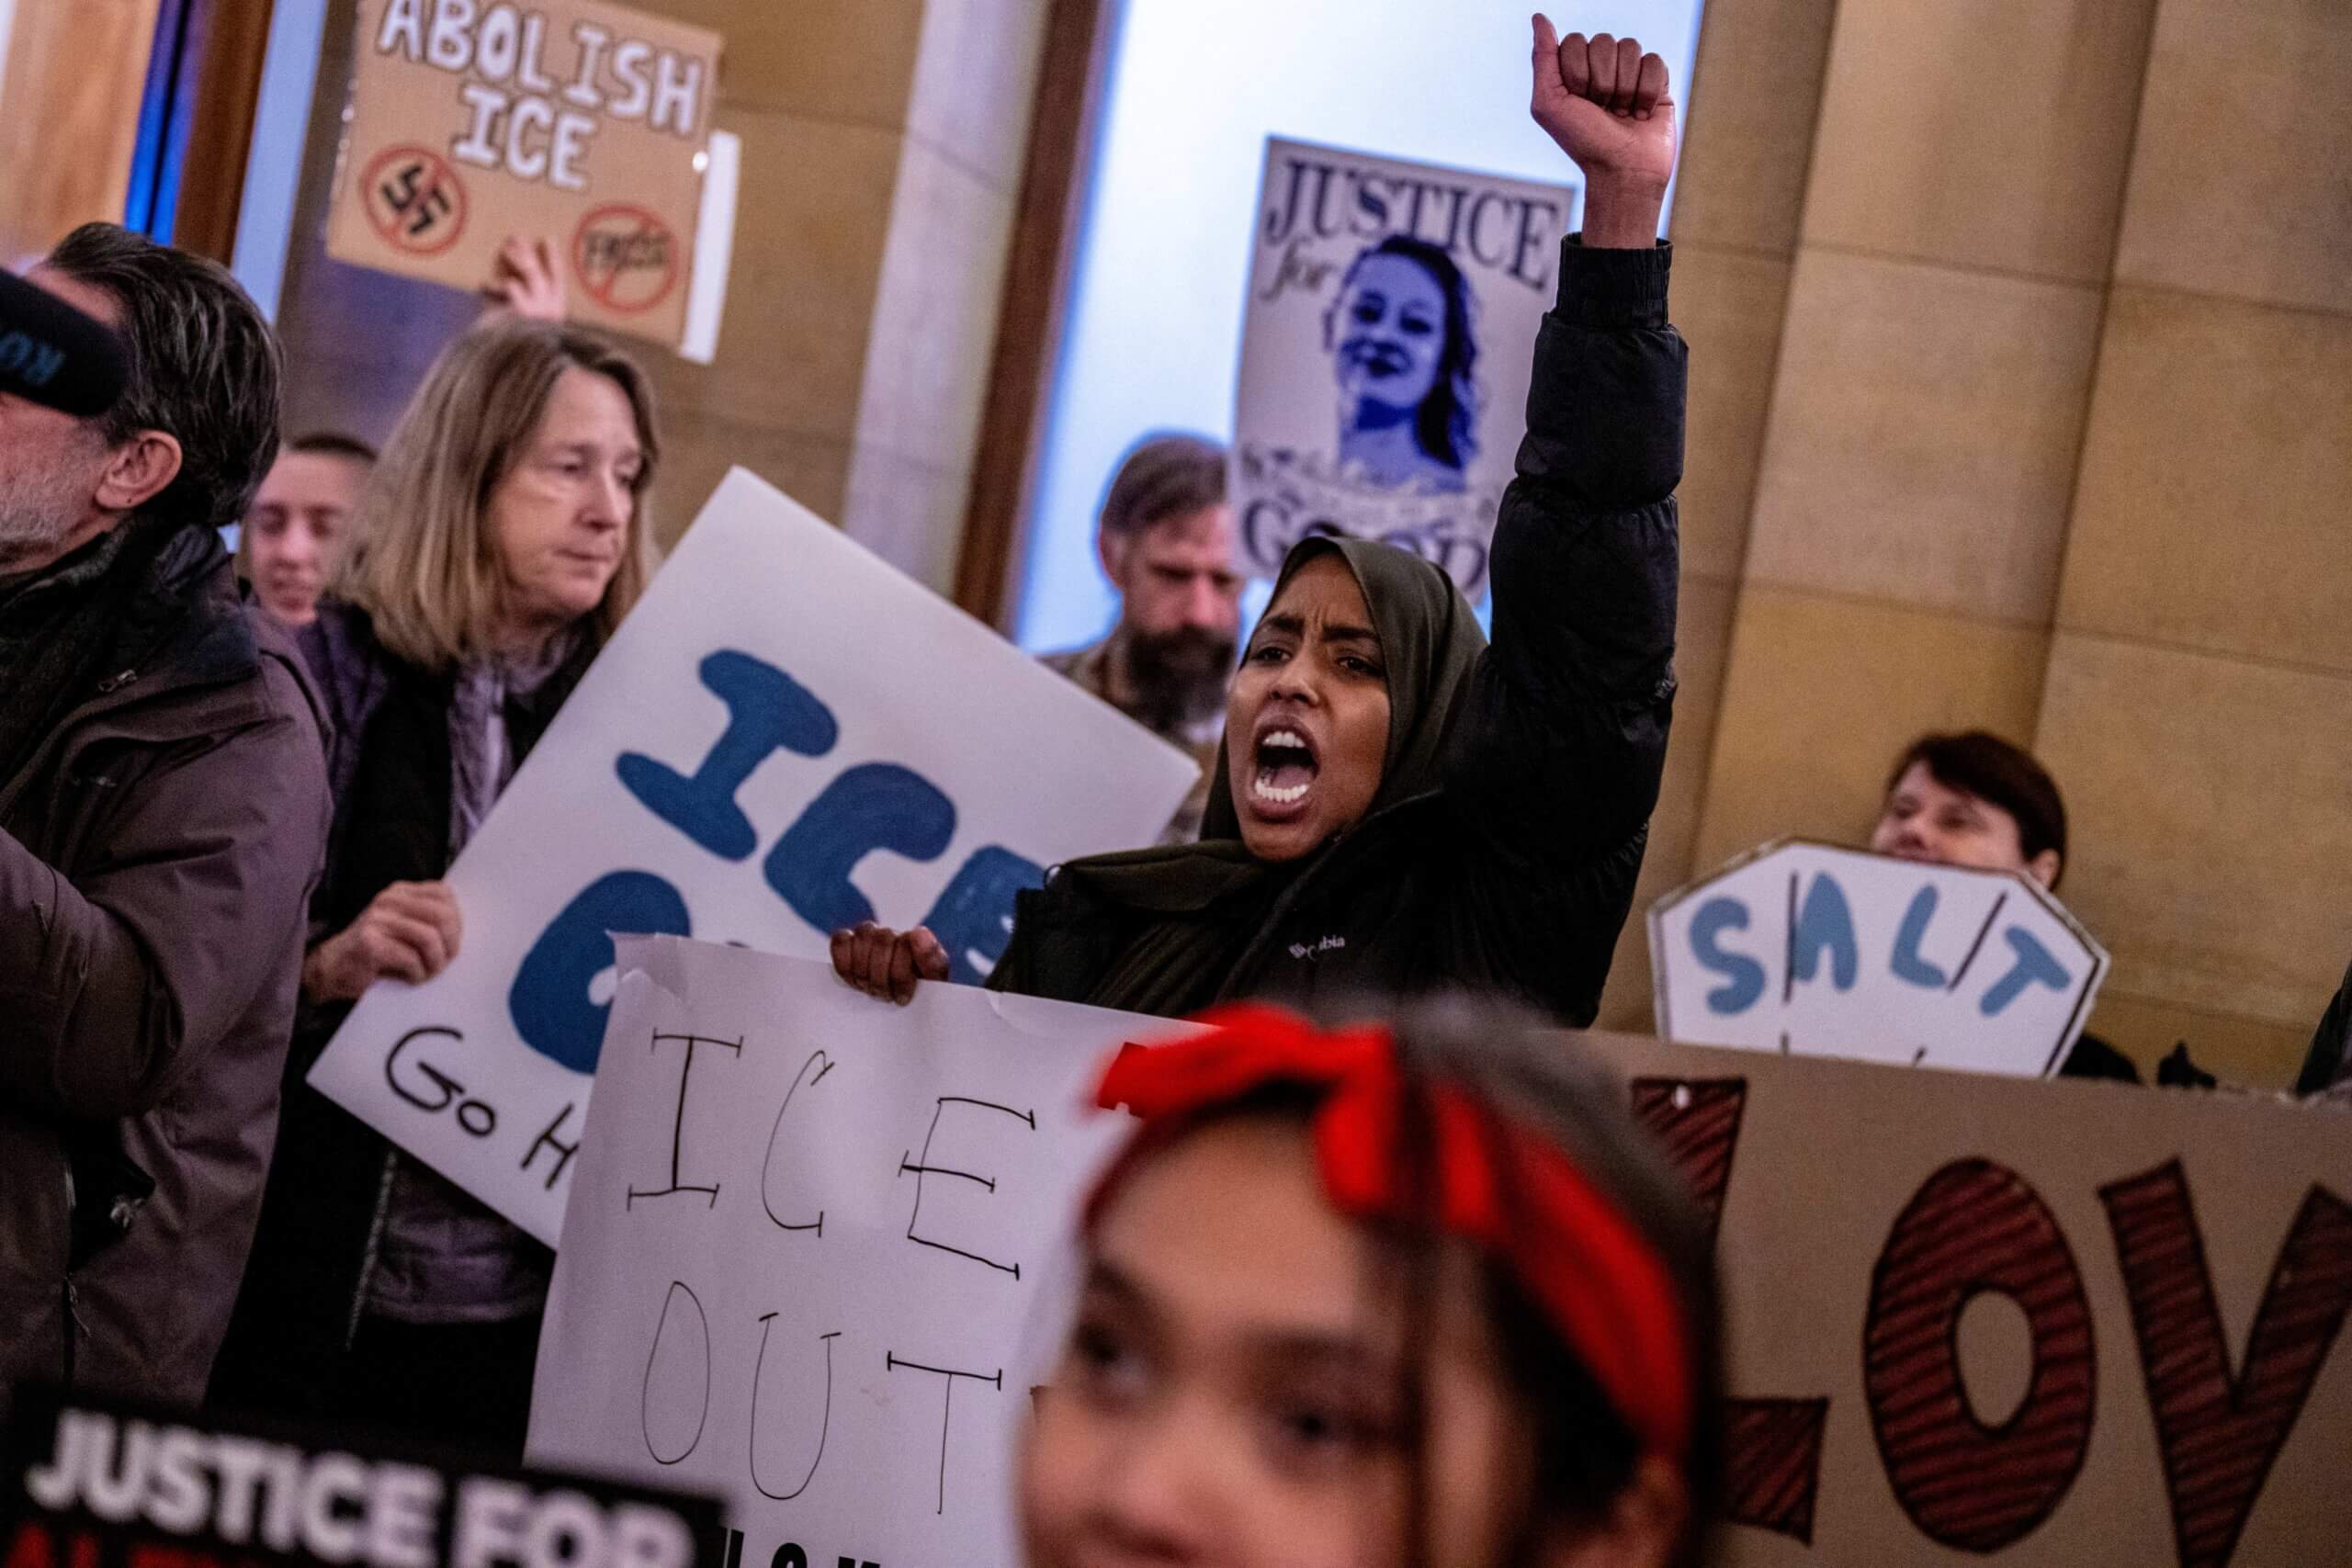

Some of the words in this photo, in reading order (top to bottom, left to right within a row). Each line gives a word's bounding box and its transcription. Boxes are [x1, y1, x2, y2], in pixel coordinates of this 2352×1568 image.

[379, 0, 703, 135] ABOLISH
[452, 85, 598, 189] ICE
[1264, 159, 1559, 292] JUSTICE
[1688, 871, 2073, 1017] SALT
[627, 1026, 1036, 1281] ICE
[642, 1280, 1002, 1516] OUT
[25, 1406, 447, 1566] JUSTICE
